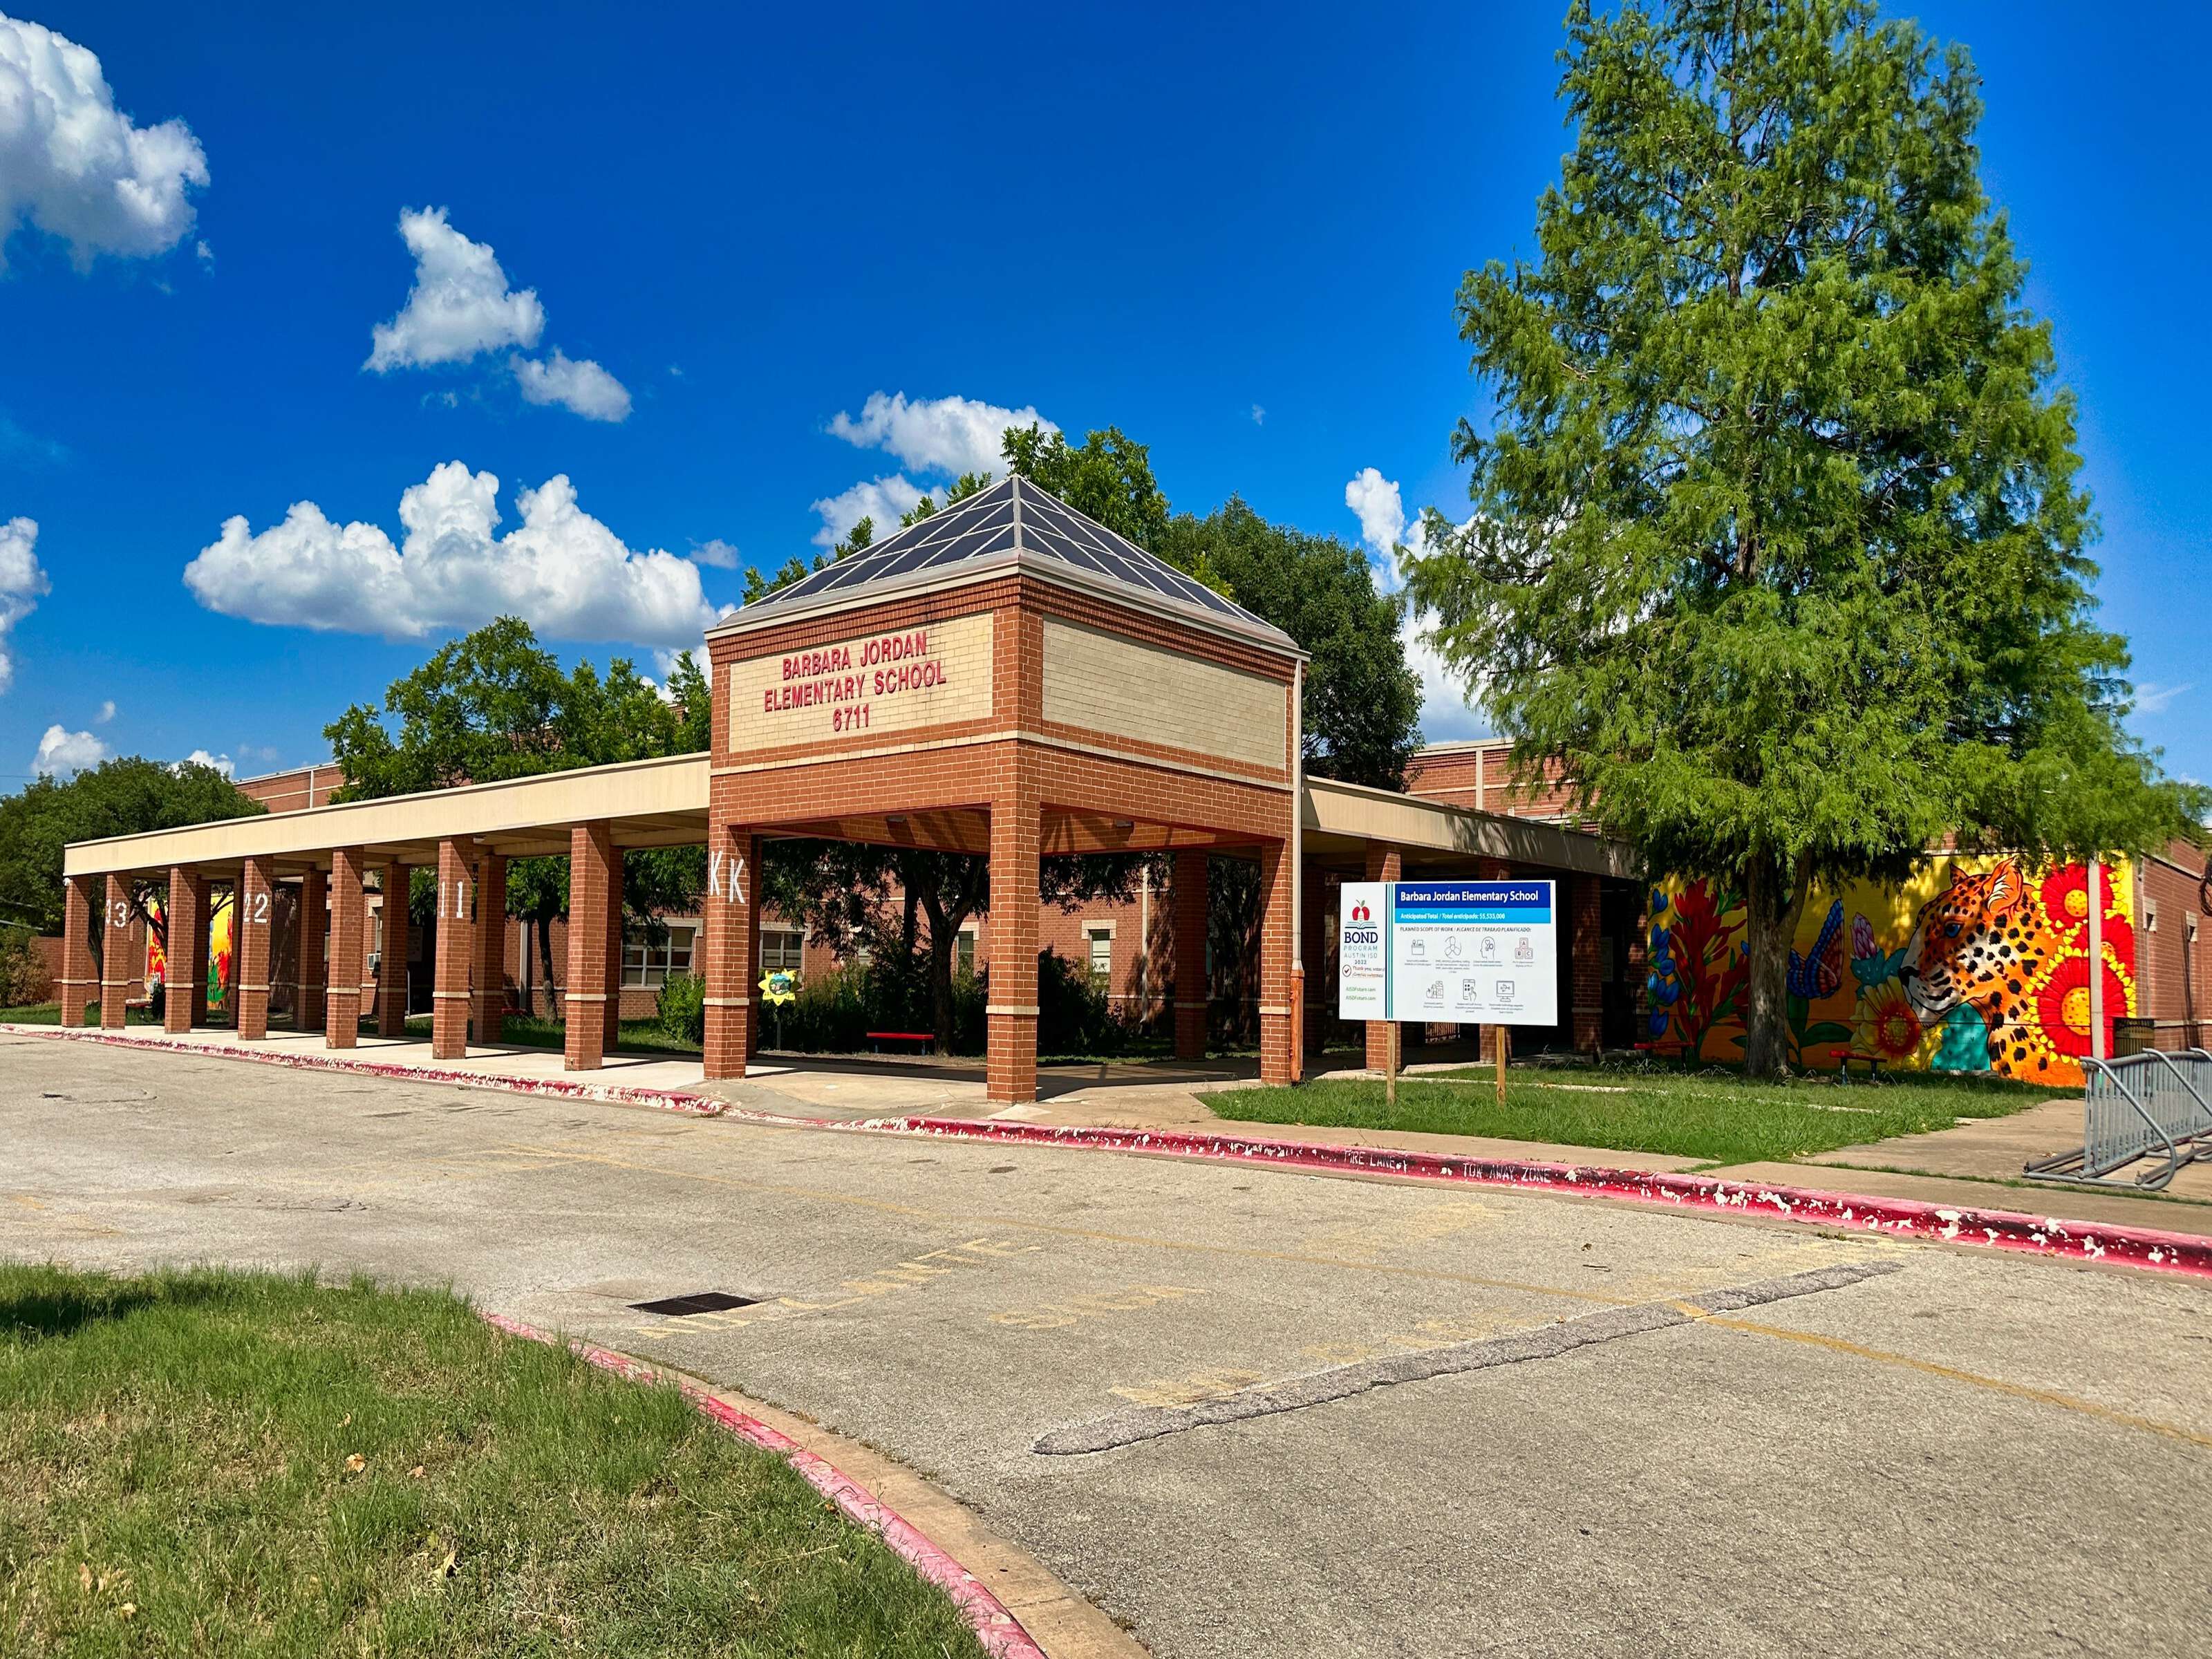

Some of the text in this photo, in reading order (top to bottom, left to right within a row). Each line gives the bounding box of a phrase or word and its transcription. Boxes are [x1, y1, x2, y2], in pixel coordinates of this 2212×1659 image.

[782, 630, 927, 680] BARBARA JORDAN
[764, 661, 946, 712] ELEMENTARY SCHOOL
[833, 703, 870, 732] 6711
[710, 851, 722, 896] K
[729, 859, 745, 903] K
[254, 892, 268, 923] 2
[456, 881, 464, 918] 1
[1400, 890, 1538, 903] Barbara Jordan Elementary School
[114, 902, 126, 928] 3
[1344, 931, 1378, 944] BOND
[1463, 1163, 1552, 1183] TOW AWAY ZONE
